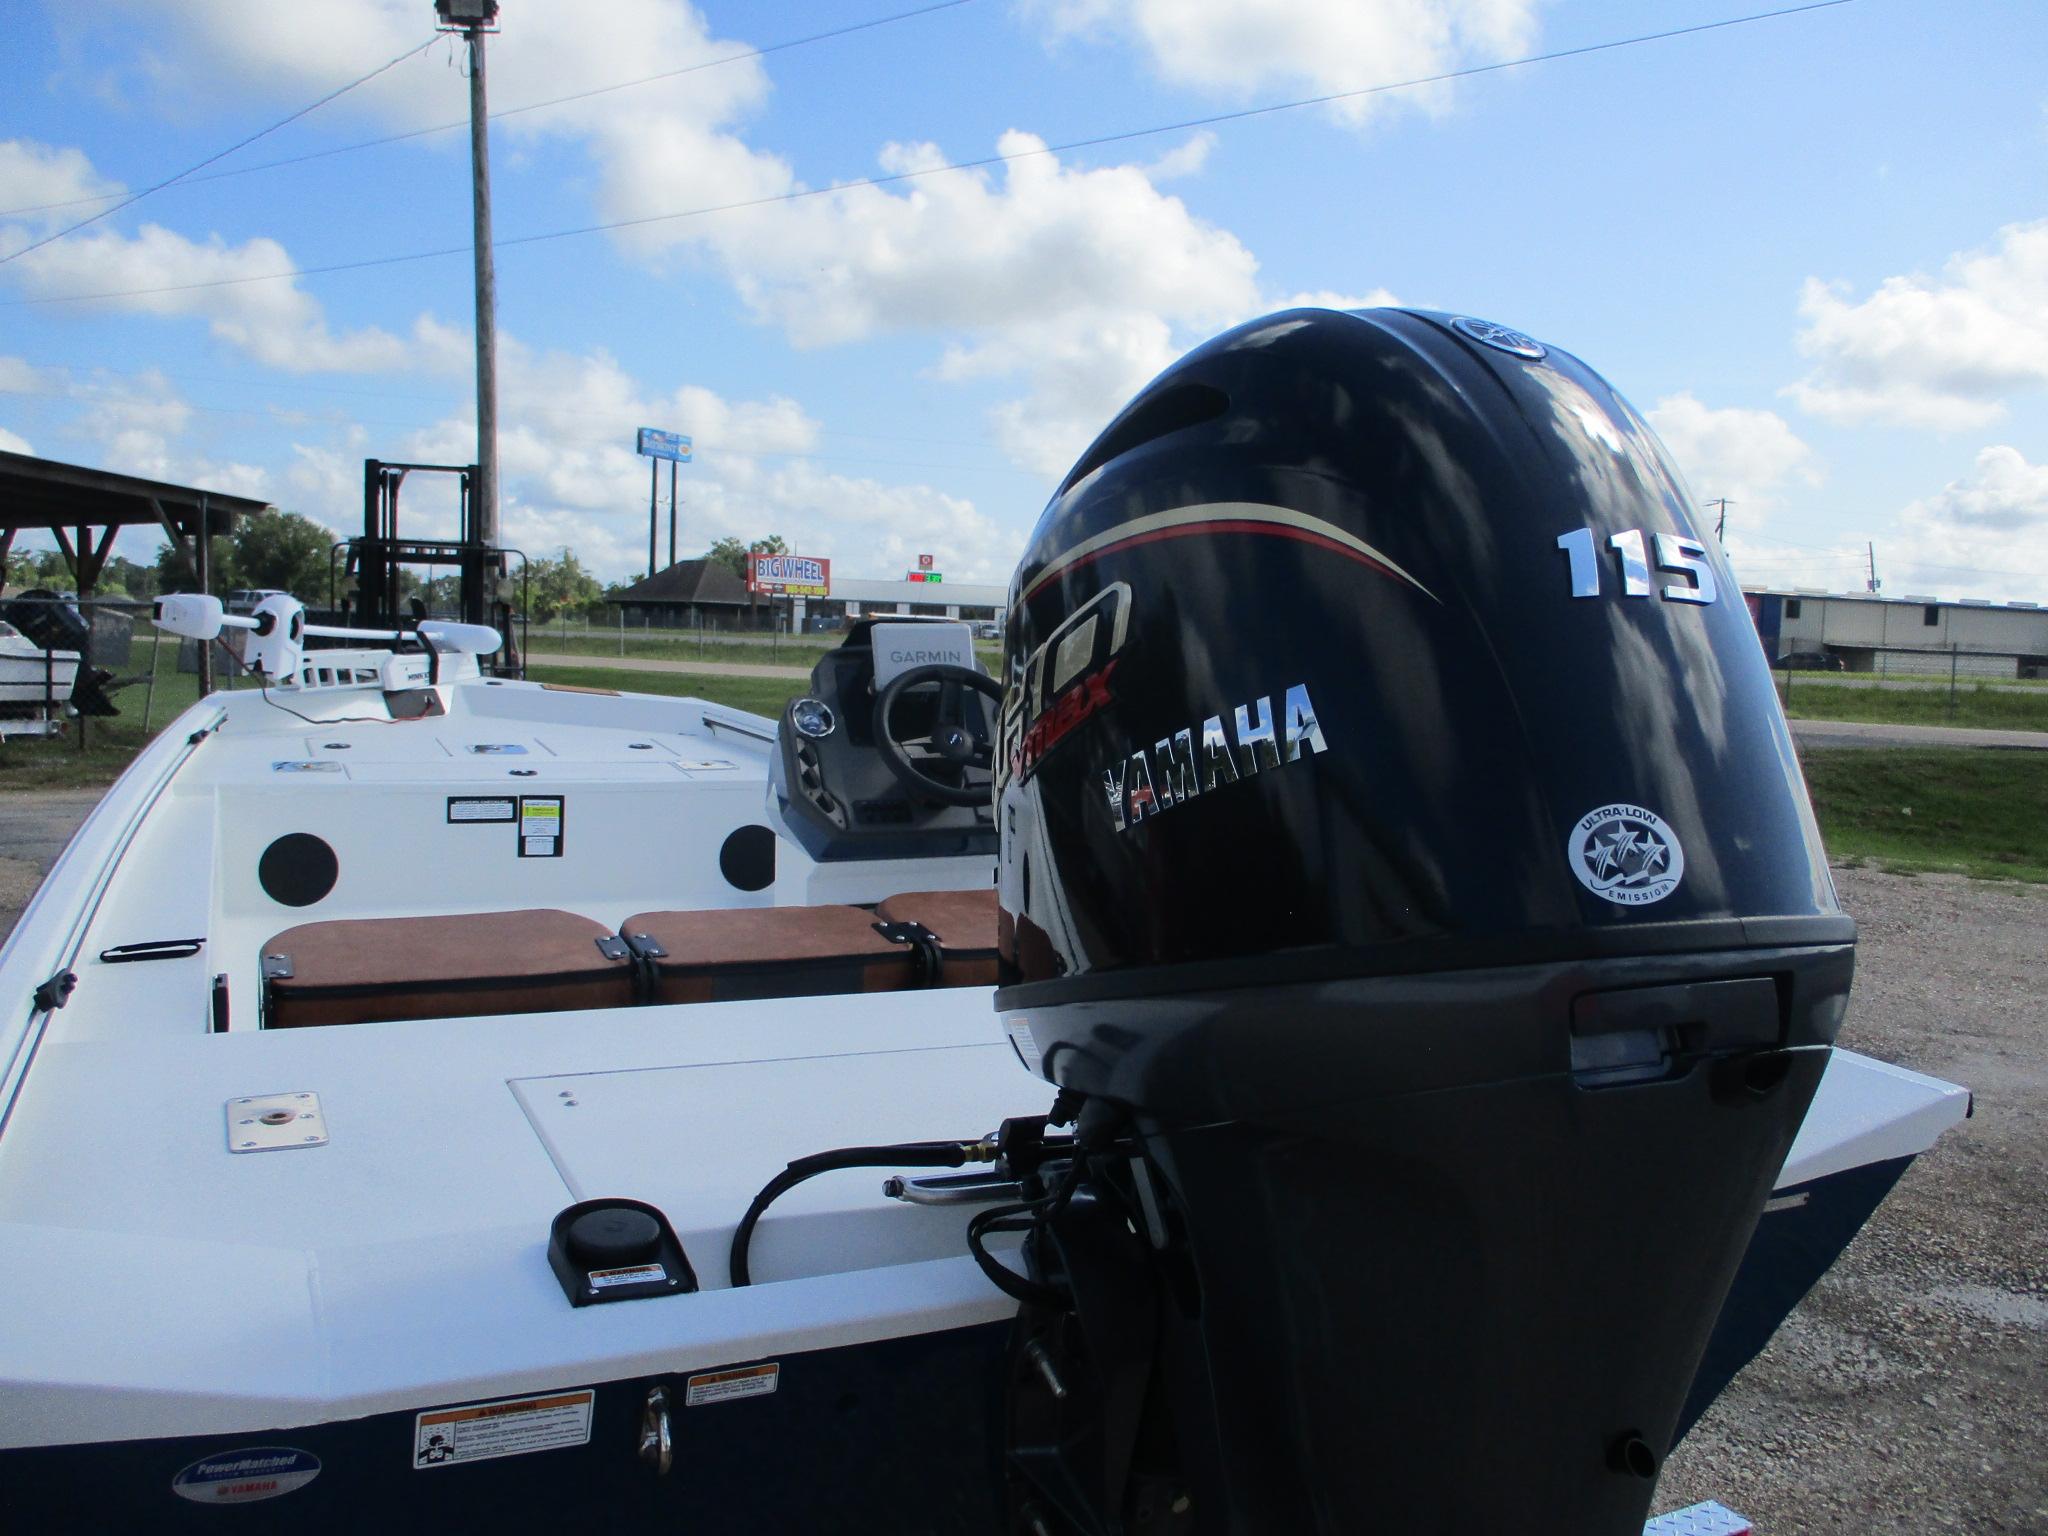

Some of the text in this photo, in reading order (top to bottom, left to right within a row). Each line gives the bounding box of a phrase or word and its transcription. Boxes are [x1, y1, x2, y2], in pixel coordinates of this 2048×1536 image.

[757, 557, 824, 581] BIG WHEEL
[1557, 527, 1717, 606] 115
[890, 651, 961, 663] GARMIN
[1103, 683, 1328, 832] YAMAHA
[1608, 884, 1670, 901] EMISSION
[487, 1401, 537, 1416] WARNING
[197, 1454, 298, 1475] PowerMatched
[230, 1480, 278, 1494] YAMAHA
